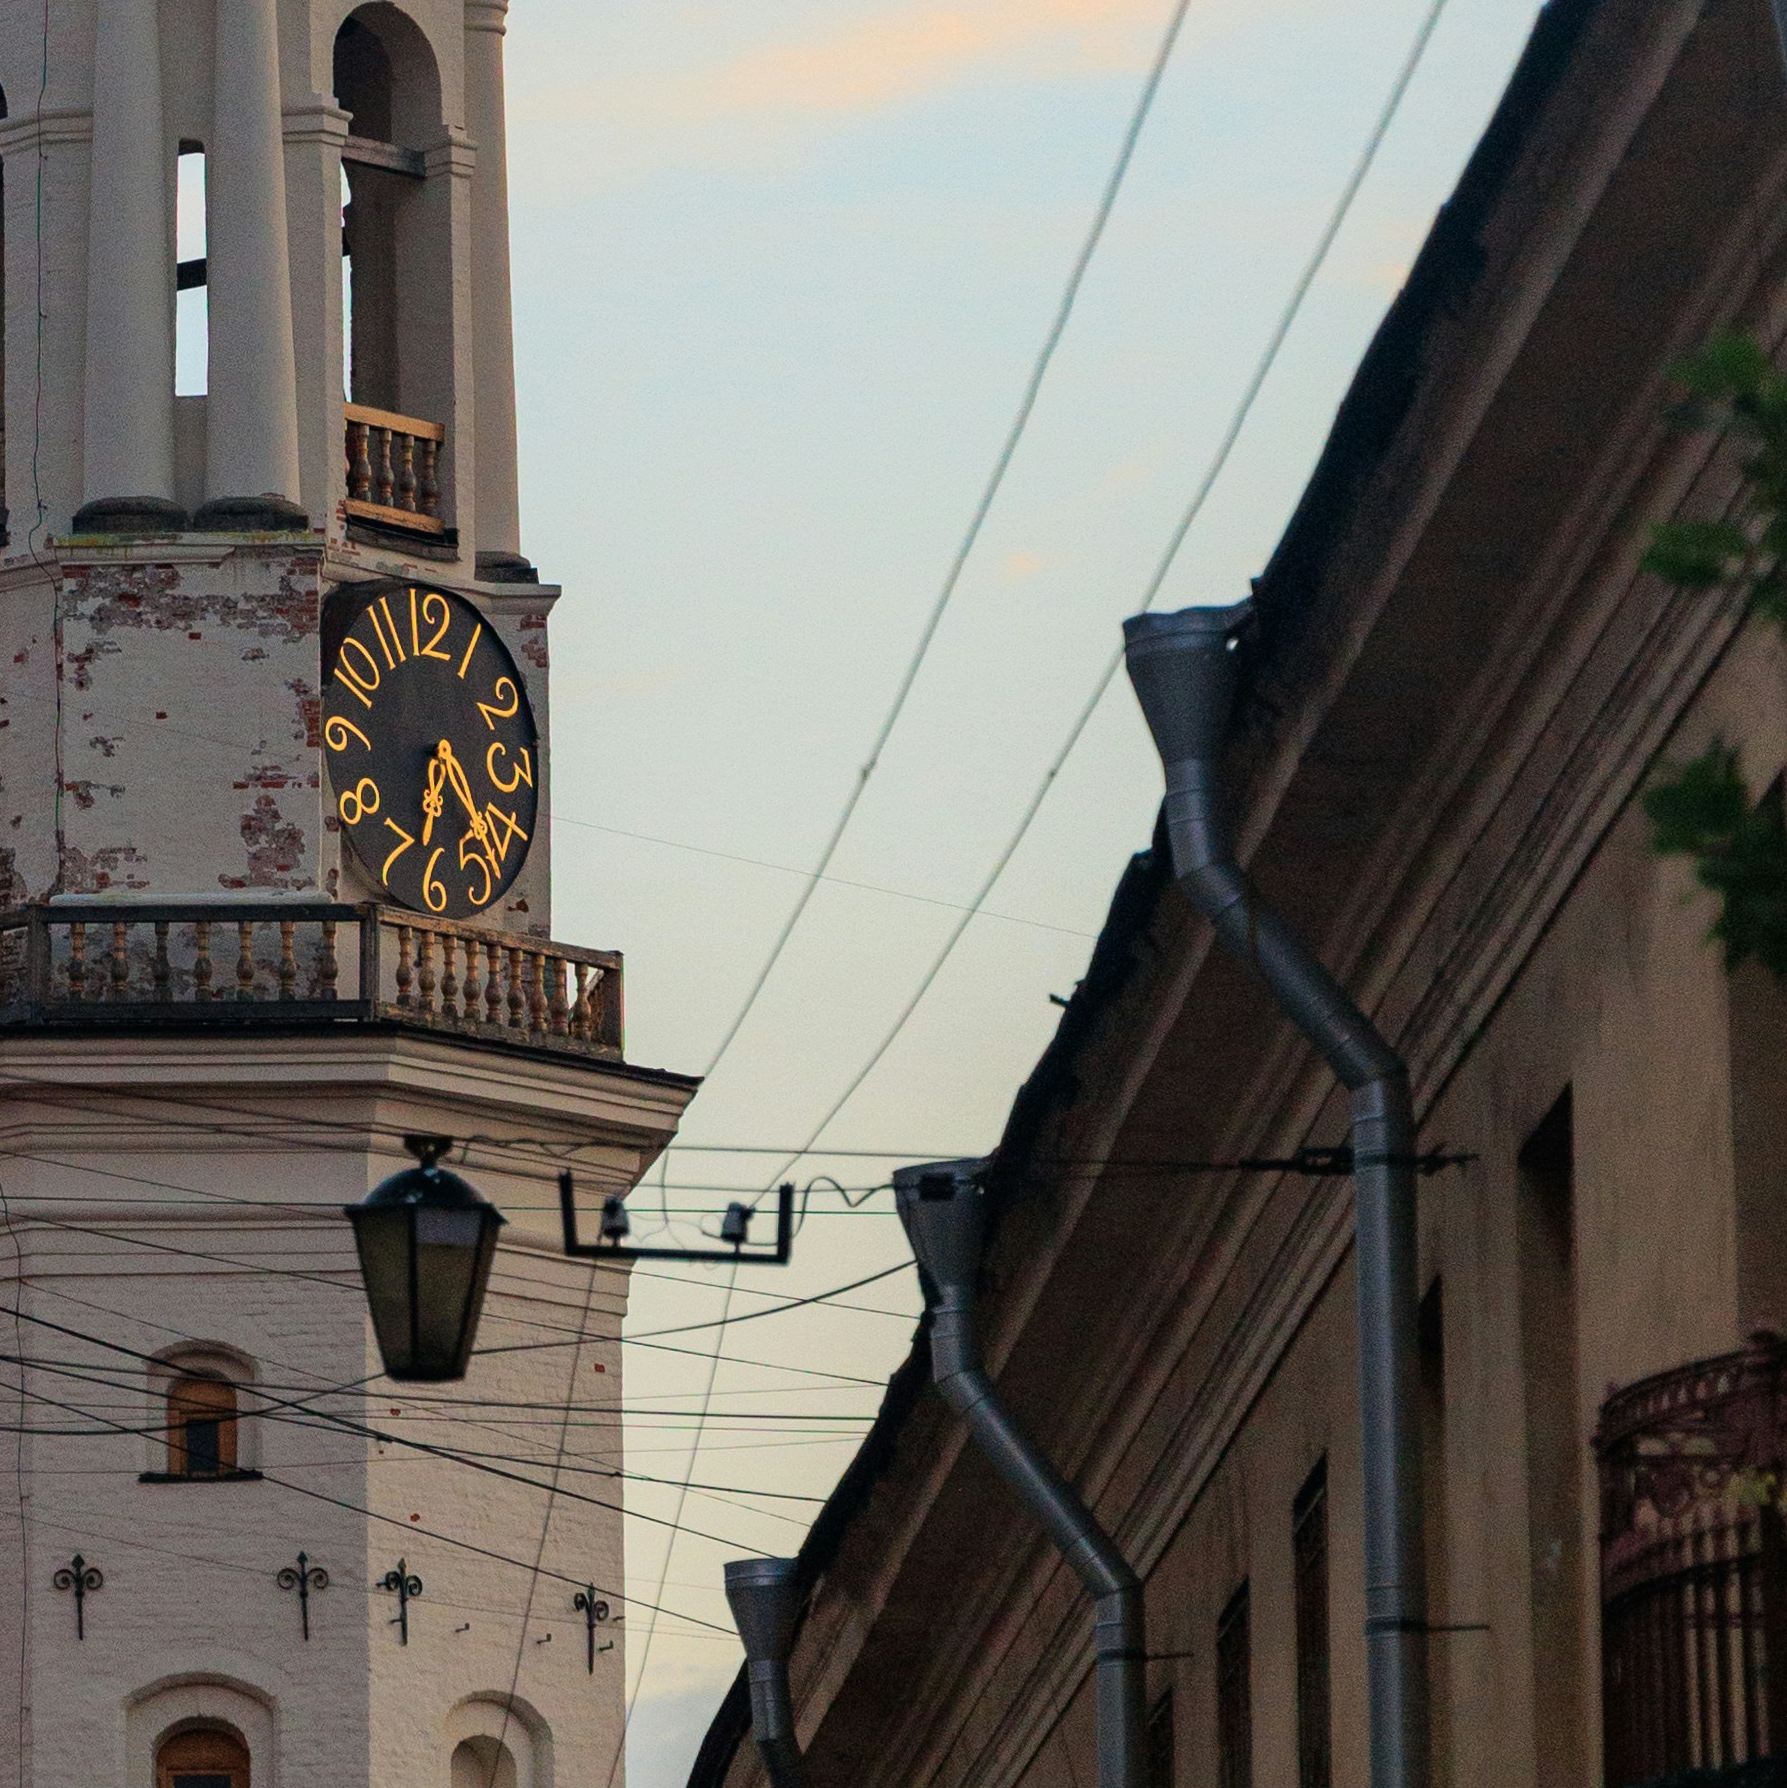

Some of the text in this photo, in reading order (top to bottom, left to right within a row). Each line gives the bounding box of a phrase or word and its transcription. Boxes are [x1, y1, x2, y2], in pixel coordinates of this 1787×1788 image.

[366, 596, 406, 670] 11
[409, 588, 451, 661] 12
[457, 623, 482, 679] 1
[334, 637, 380, 709] 10
[476, 676, 519, 731] 2
[325, 716, 371, 752] 9
[486, 742, 533, 793] 3
[340, 778, 380, 825] 8
[485, 802, 528, 861] 4
[382, 817, 415, 886] 7
[423, 847, 447, 912] 6
[459, 829, 491, 905] 5
